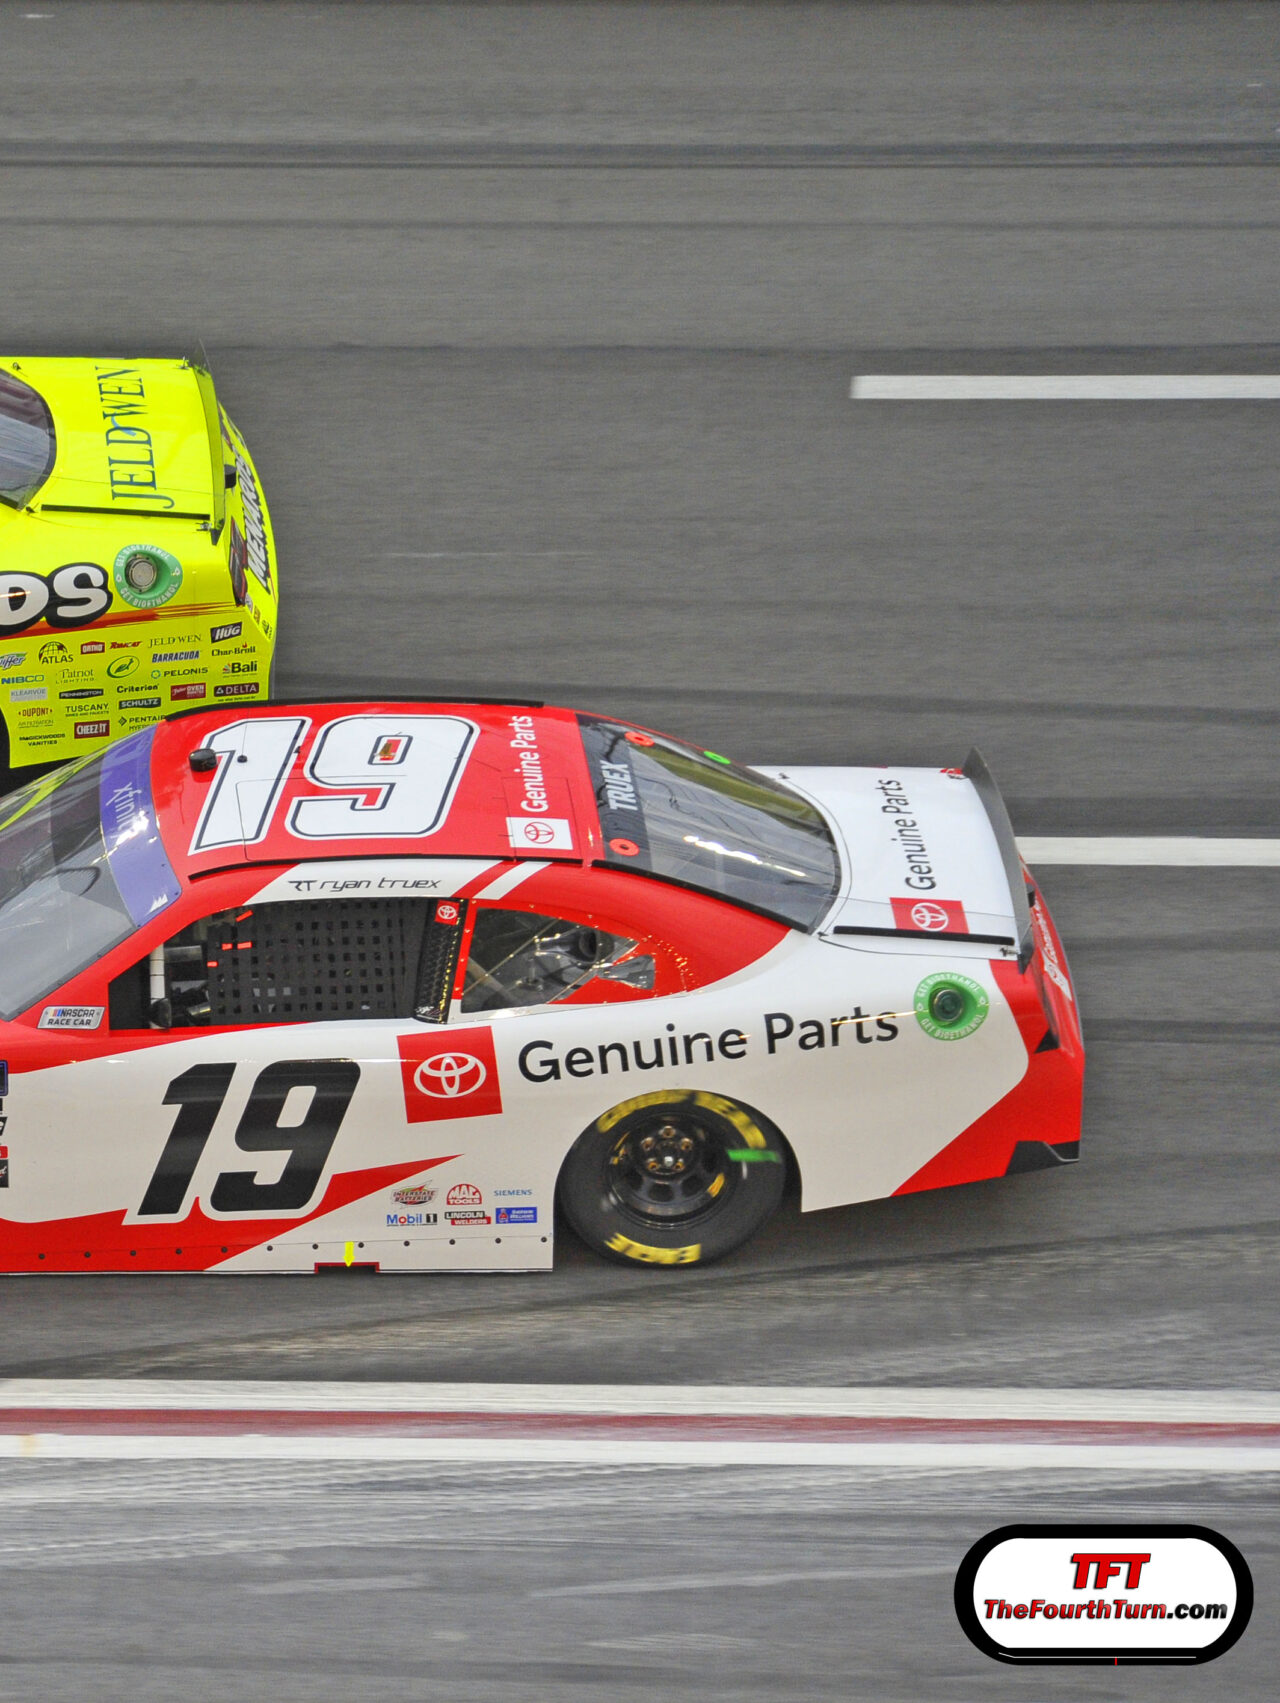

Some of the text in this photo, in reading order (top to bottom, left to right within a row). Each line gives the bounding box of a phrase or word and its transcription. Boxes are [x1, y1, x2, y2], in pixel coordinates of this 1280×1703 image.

[41, 654, 74, 664] ATLAS
[152, 651, 200, 663] BARRACUDA
[164, 667, 208, 677] PELONIS
[232, 661, 258, 673] Bali
[1, 675, 45, 684] NIBCO
[61, 669, 94, 679] Patriot
[117, 684, 158, 694] Criterion
[226, 684, 257, 694] DELTA
[121, 698, 159, 708] SCHULTZ
[508, 715, 549, 812] Genuine Parts
[189, 715, 478, 855] 19
[600, 760, 638, 811] TRUEX
[875, 779, 936, 891] Genuine Parts
[320, 880, 371, 892] ryan
[378, 877, 442, 889] truex
[60, 1008, 96, 1018] NASCAR
[518, 1006, 899, 1083] Genuine Parts
[137, 1058, 361, 1215] 19
[452, 1184, 479, 1198] MAC
[493, 1189, 532, 1197] SIEMENS
[386, 1213, 422, 1225] Mobil
[446, 1211, 484, 1219] LINCOLN
